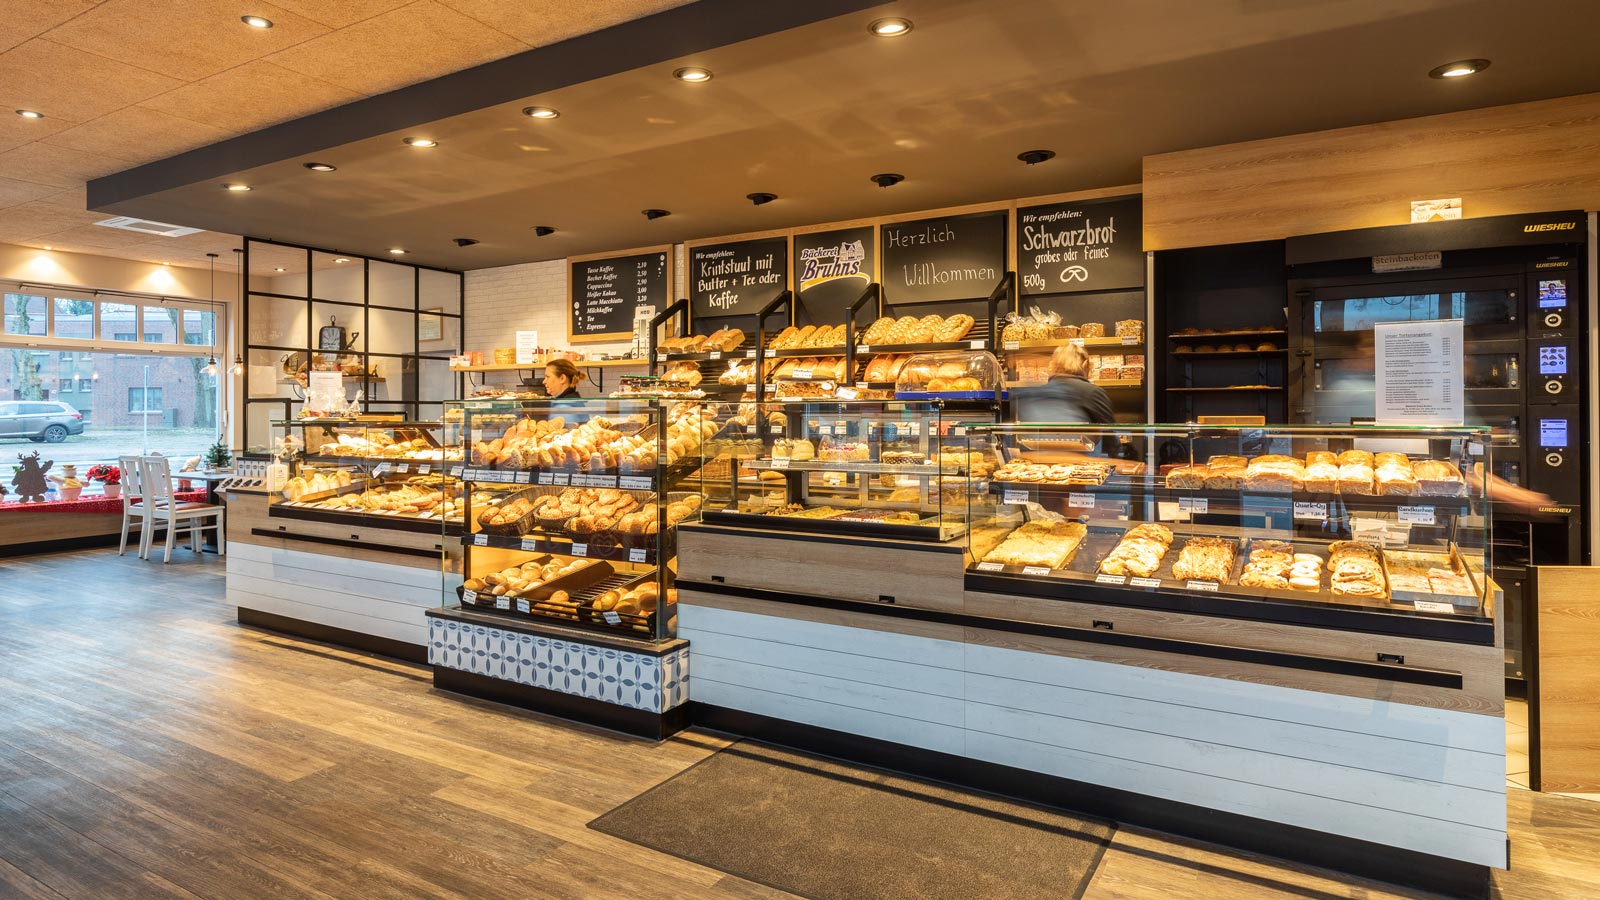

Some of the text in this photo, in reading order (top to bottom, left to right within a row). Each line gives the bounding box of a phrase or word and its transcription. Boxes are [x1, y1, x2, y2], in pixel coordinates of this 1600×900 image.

[1023, 210, 1082, 223] Wir empfehlen:
[888, 223, 955, 248] Herzlich
[1023, 216, 1117, 251] Schwarzbrot
[1524, 222, 1576, 232] WIESHEU
[756, 254, 773, 270] mit
[802, 247, 840, 259] Bäckerei
[1034, 245, 1109, 269] grobes oder feines
[802, 257, 860, 280] Bruhns
[903, 263, 995, 286] Willkommen
[698, 277, 728, 292] Butter
[742, 273, 756, 286] Tee
[759, 270, 781, 284] oder
[1024, 274, 1045, 290] 500g
[709, 290, 739, 309] Kaffee
